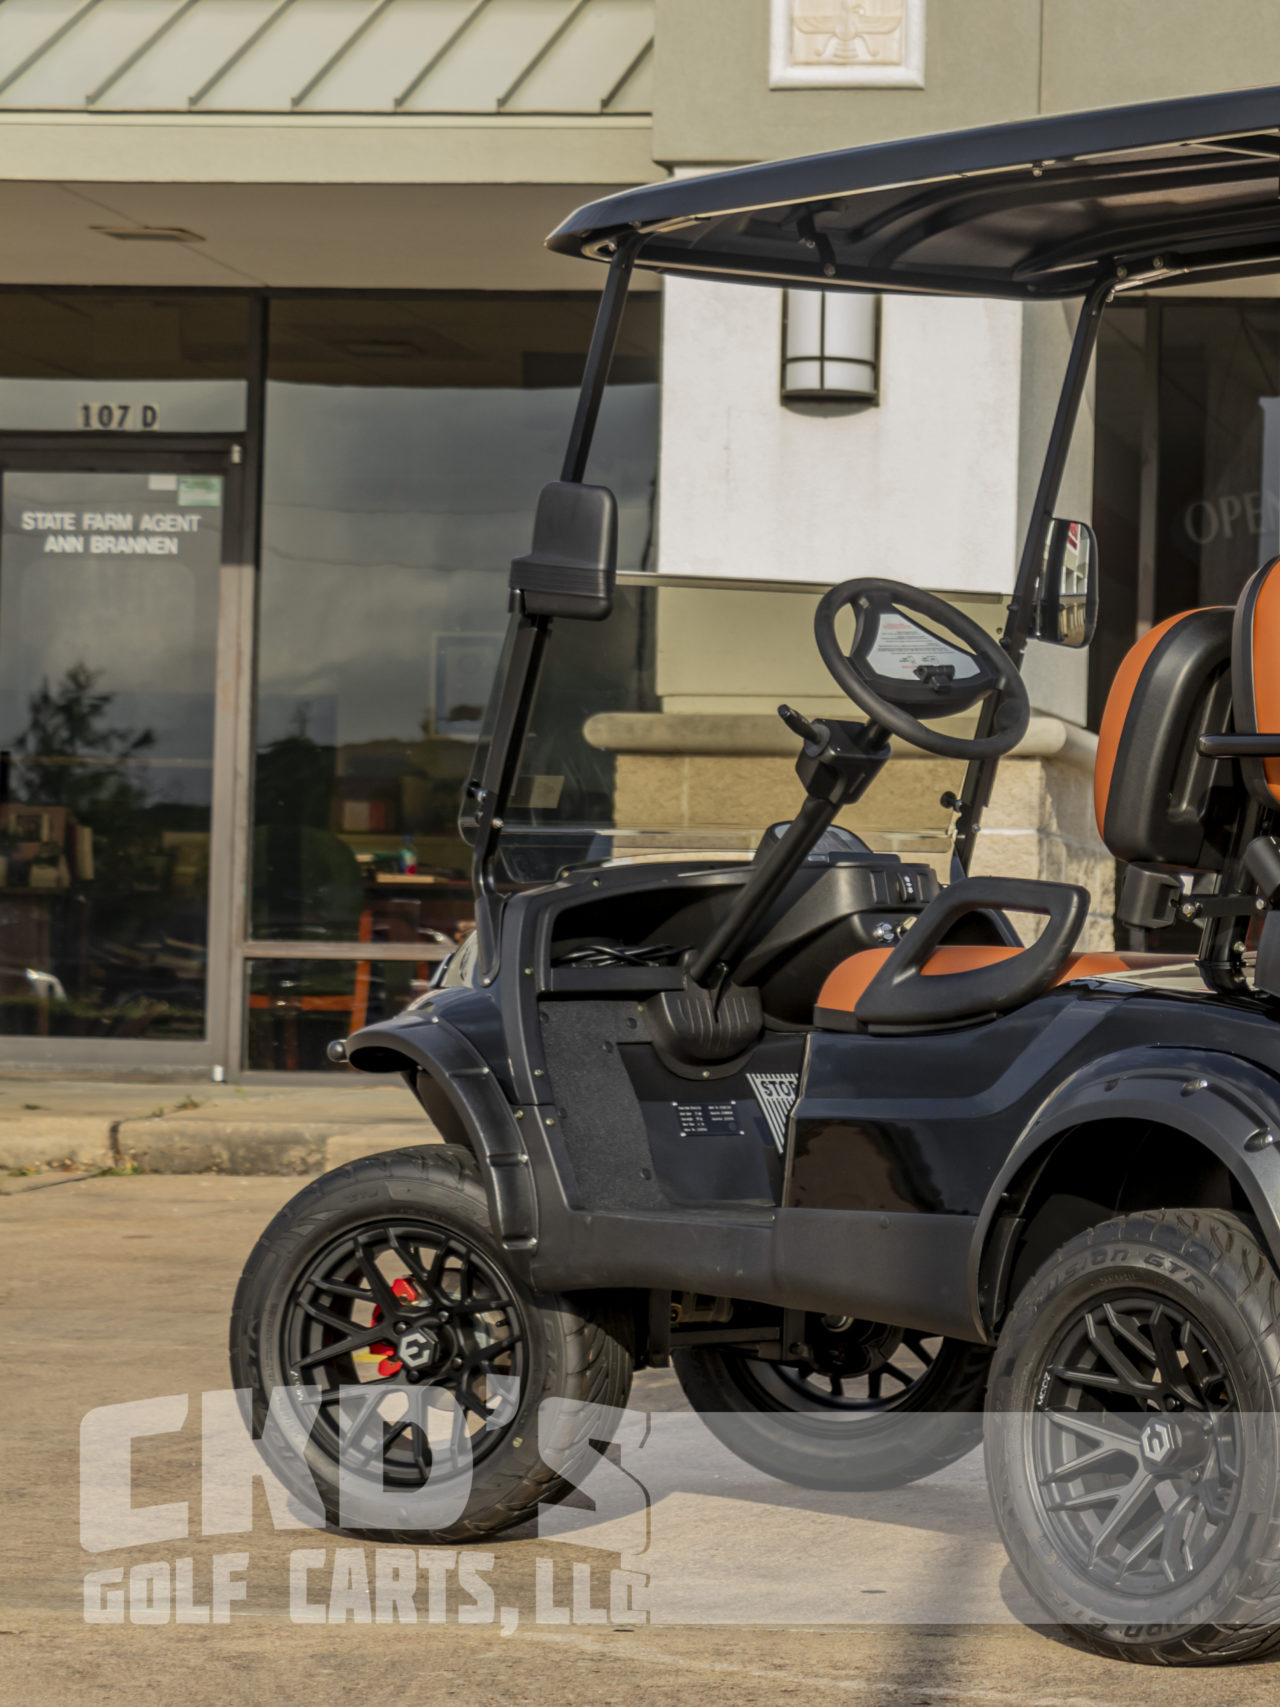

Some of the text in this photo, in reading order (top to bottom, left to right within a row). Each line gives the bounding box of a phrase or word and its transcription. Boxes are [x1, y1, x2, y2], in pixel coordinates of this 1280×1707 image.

[81, 405, 157, 428] 107 D
[21, 511, 202, 532] STATE FARM AGENT
[44, 535, 179, 554] ANN BRANNEN
